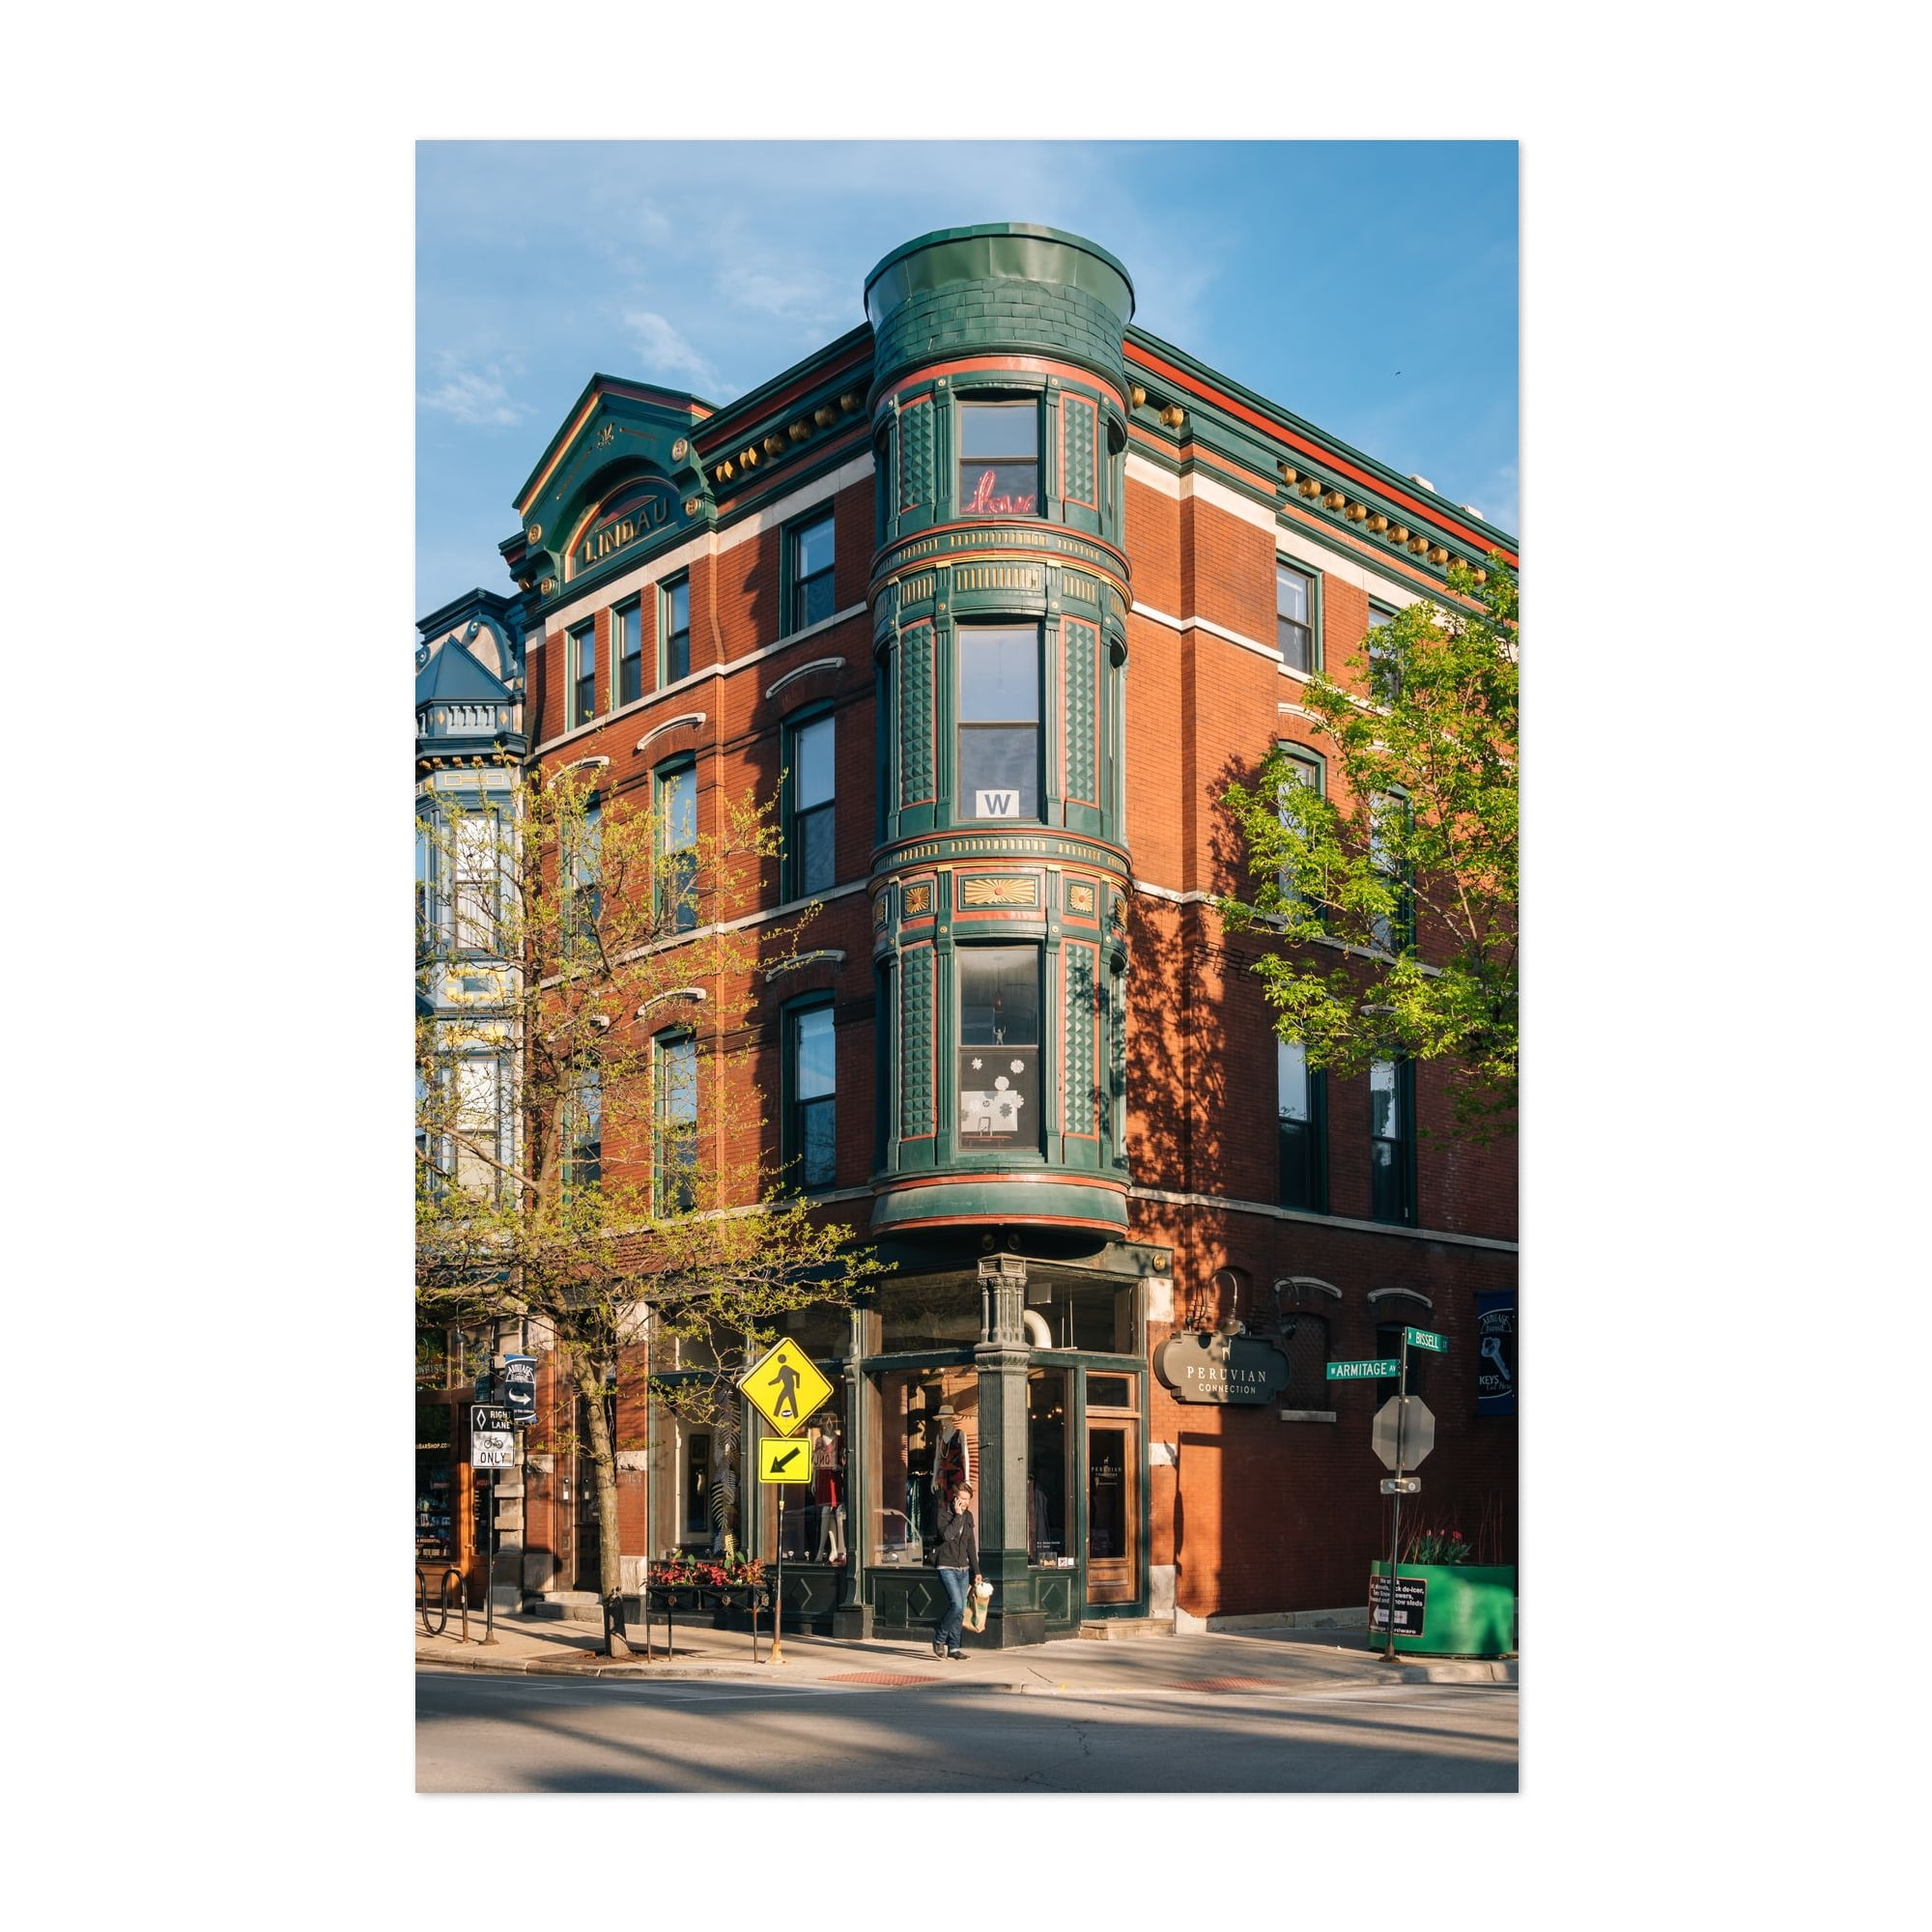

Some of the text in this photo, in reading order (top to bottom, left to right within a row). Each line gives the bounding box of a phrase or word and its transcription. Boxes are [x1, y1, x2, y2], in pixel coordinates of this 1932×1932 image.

[584, 497, 668, 562] LINDAU
[984, 794, 1011, 814] W
[1415, 1332, 1439, 1349] BISSELL
[1187, 1366, 1266, 1382] PERUVIAN
[1337, 1362, 1387, 1377] ARMITAGE
[1479, 1375, 1499, 1385] KEYS
[1198, 1383, 1256, 1395] CONNECTION
[490, 1410, 511, 1420] RIGHT
[492, 1421, 511, 1430] LANE
[480, 1452, 505, 1463] ONLY
